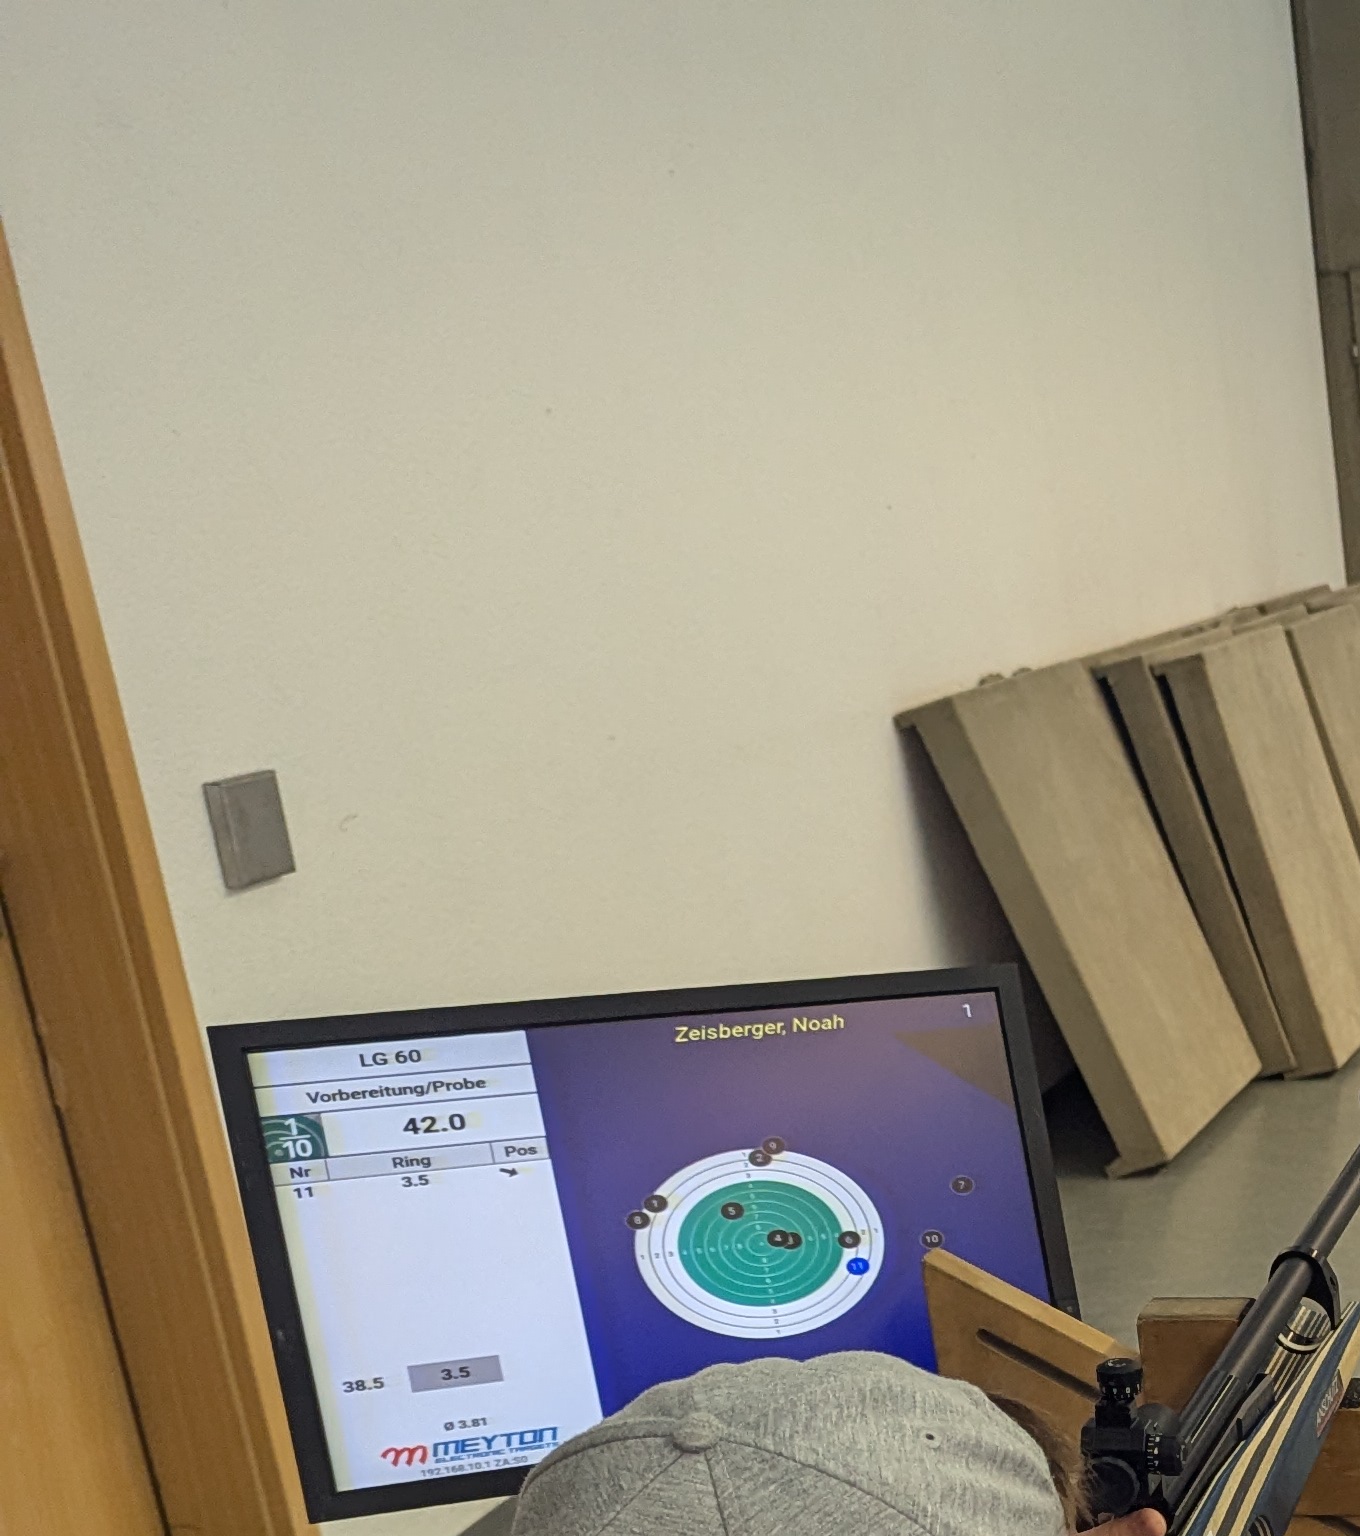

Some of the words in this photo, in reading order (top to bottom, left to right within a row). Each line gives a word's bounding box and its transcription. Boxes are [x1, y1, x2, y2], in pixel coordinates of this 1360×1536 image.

[962, 1003, 973, 1018] 1
[674, 1020, 787, 1043] Zeisberger,
[793, 1014, 845, 1033] Noah
[359, 1052, 388, 1068] LG
[395, 1049, 422, 1064] 60
[306, 1077, 487, 1104] Vorbereitung/Probe
[284, 1118, 297, 1135] 1
[403, 1113, 467, 1135] 42.0
[282, 1138, 313, 1159] 10
[290, 1166, 311, 1179] Nr
[392, 1155, 432, 1172] Ring
[504, 1144, 538, 1158] Pos
[293, 1186, 314, 1199] 11
[401, 1174, 429, 1188] 3.5
[342, 1377, 385, 1393] 38.5
[441, 1366, 471, 1381] 3.5
[458, 1417, 488, 1429] 3.81
[432, 1426, 559, 1457] MEYTON
